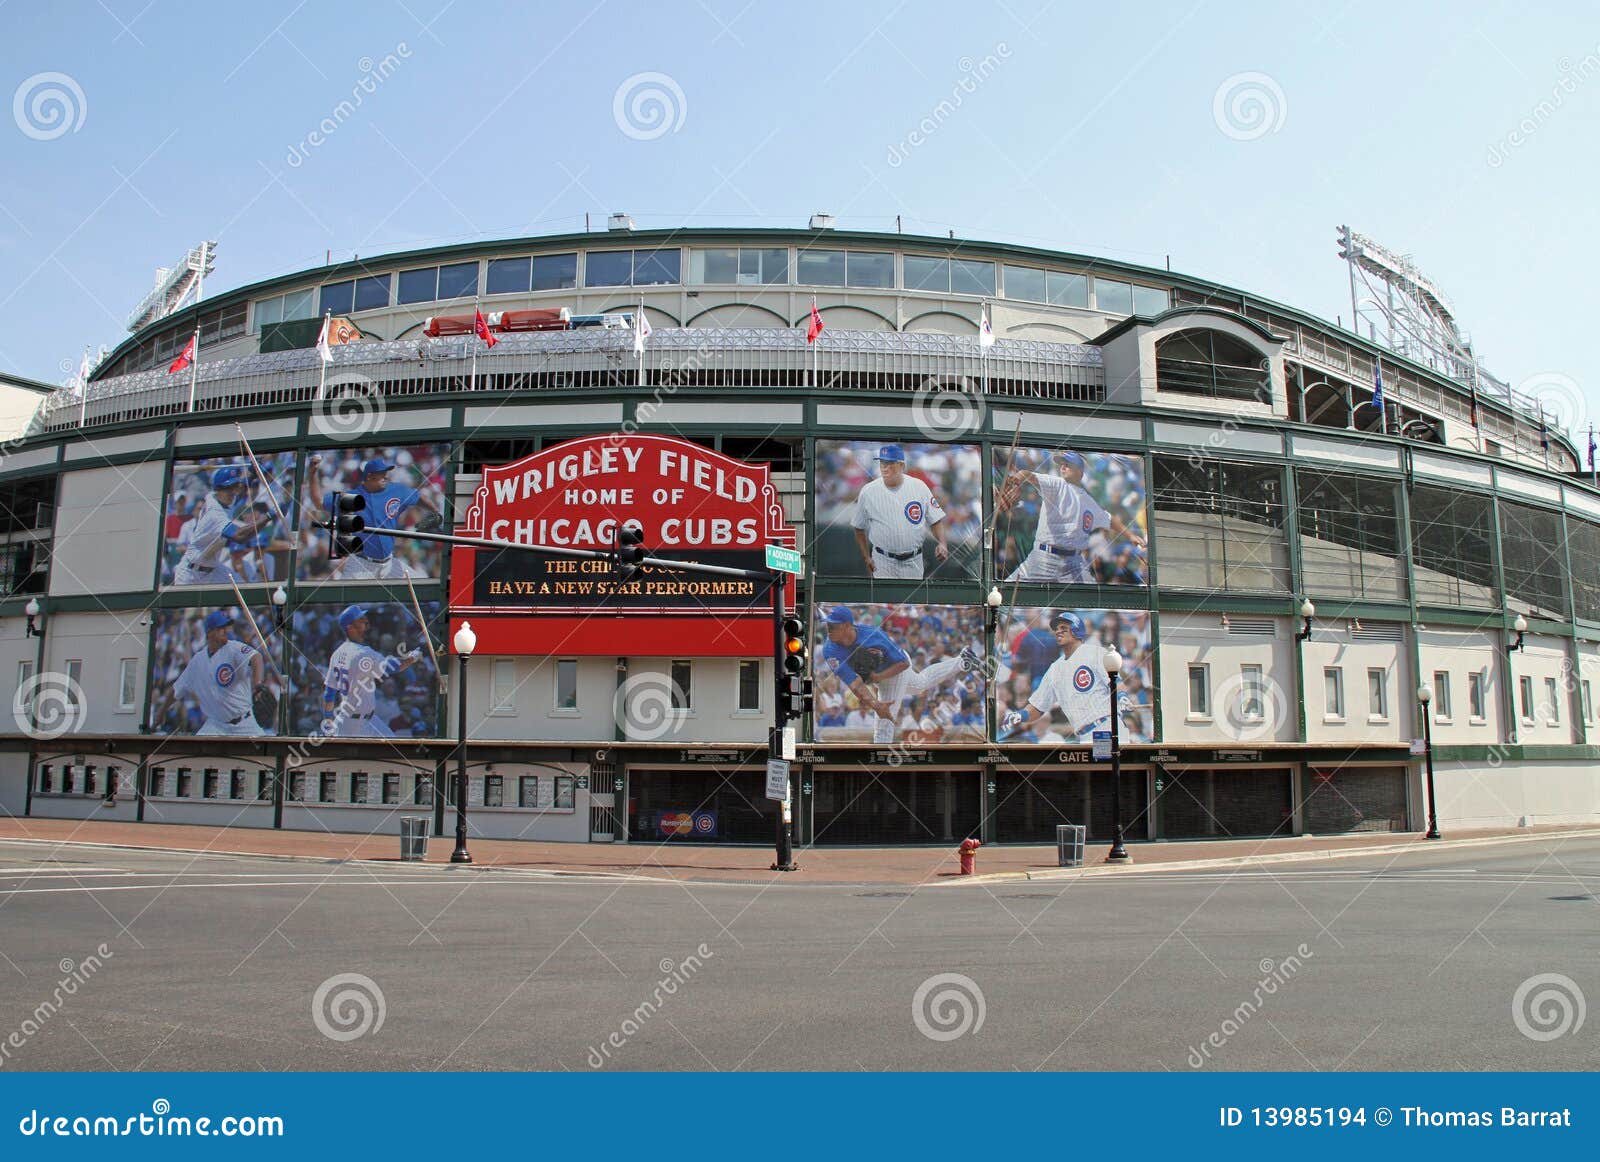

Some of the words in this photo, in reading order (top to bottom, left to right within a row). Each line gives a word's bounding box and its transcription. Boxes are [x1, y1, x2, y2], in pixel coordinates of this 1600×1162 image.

[493, 447, 644, 506] WRIGLEY
[659, 449, 757, 503] FIELD
[565, 488, 634, 505] HOME
[652, 488, 685, 505] OF
[661, 518, 758, 545] CUBS
[544, 560, 577, 573] THE
[489, 582, 536, 595] HAVE
[539, 582, 551, 595] A
[554, 582, 593, 594] NEW
[597, 582, 642, 594] STAR
[645, 582, 754, 595] PERFORMER!
[595, 750, 606, 761] G
[1059, 751, 1089, 762] GATE
